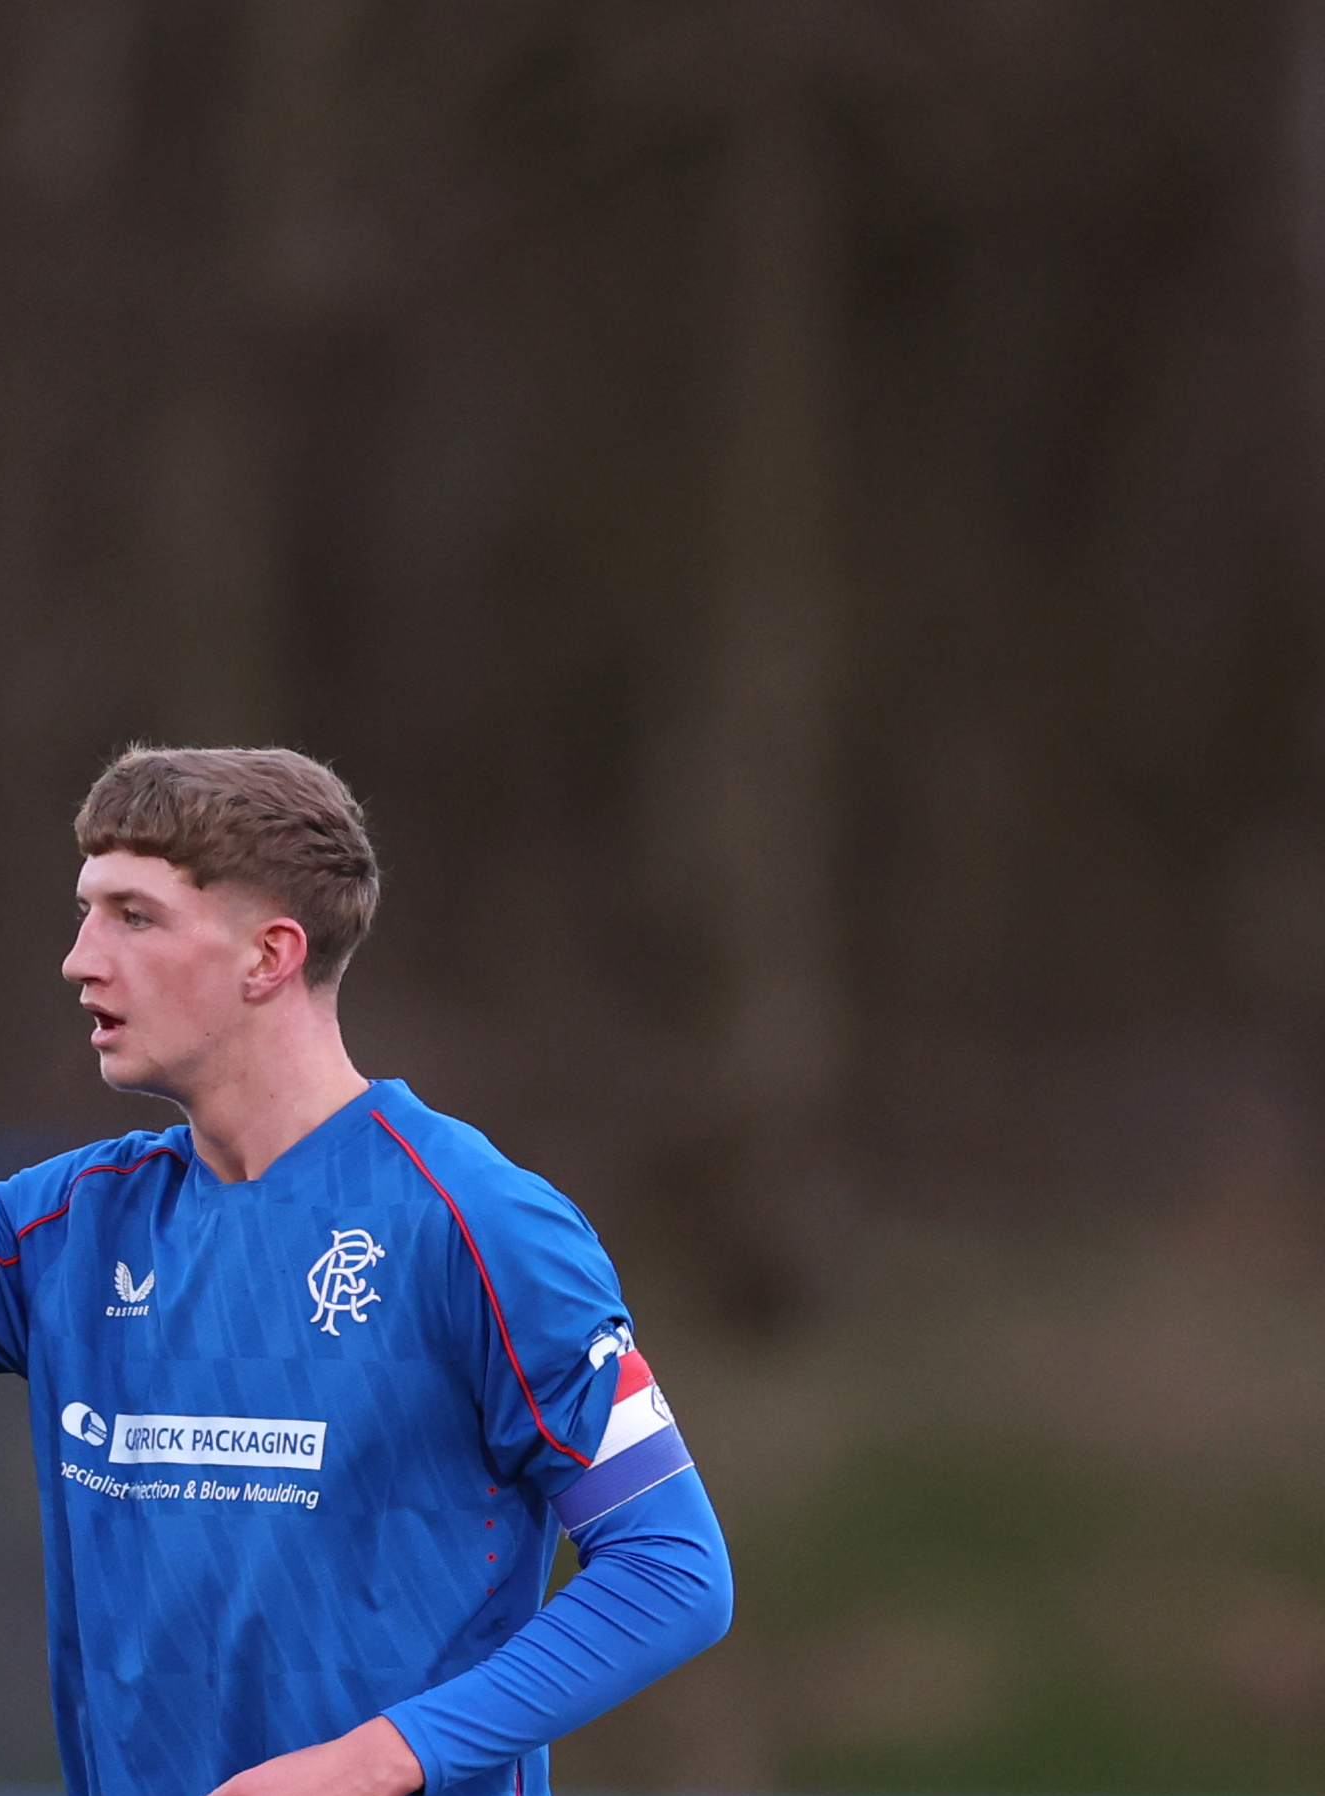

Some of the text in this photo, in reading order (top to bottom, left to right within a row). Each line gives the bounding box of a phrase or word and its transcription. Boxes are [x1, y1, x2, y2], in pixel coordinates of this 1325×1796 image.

[105, 1304, 150, 1318] CASTORE
[191, 1429, 316, 1456] PACKAGING
[183, 1480, 197, 1500] &
[200, 1480, 241, 1501] Blow
[243, 1483, 319, 1510] Moulding
